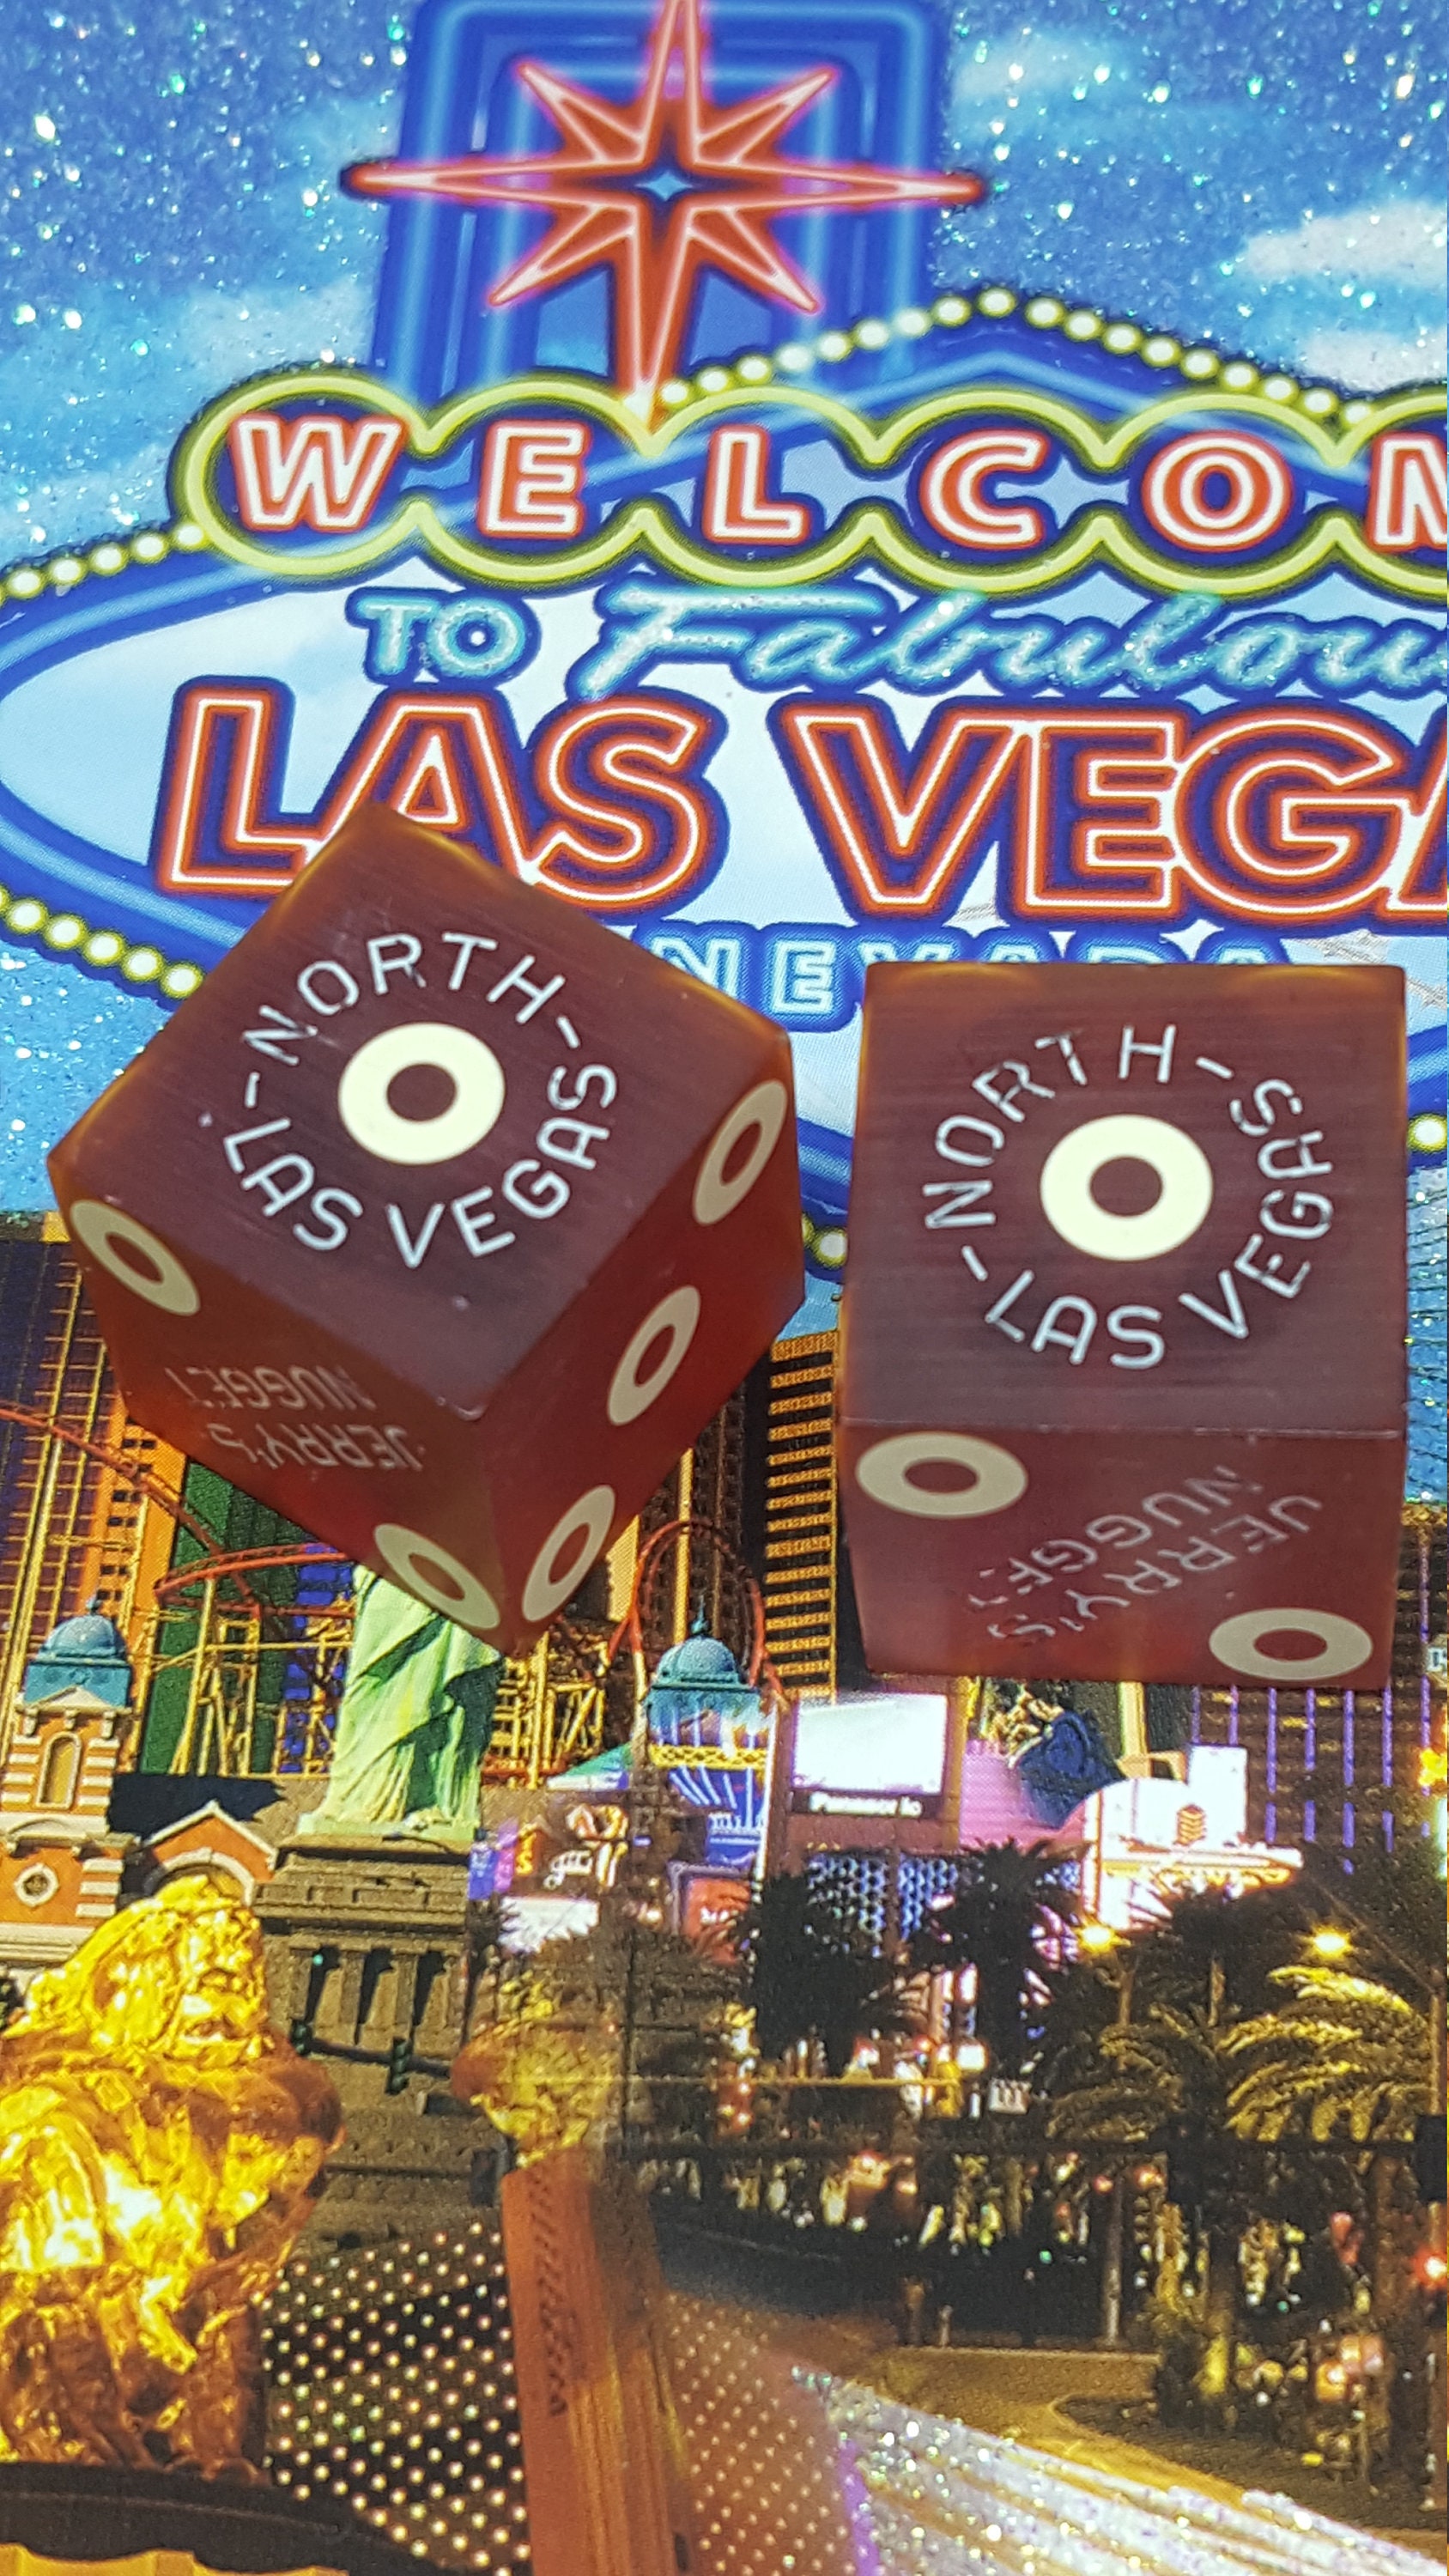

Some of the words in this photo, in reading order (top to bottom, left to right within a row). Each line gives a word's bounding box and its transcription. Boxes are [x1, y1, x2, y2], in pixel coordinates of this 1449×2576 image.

[353, 592, 526, 680] TO
[157, 683, 711, 914] LAS
[222, 1118, 364, 1251] LAS
[387, 1063, 618, 1269] VEGAS
[986, 1270, 1166, 1370] LAS
[1179, 1078, 1334, 1340] VEGAS
